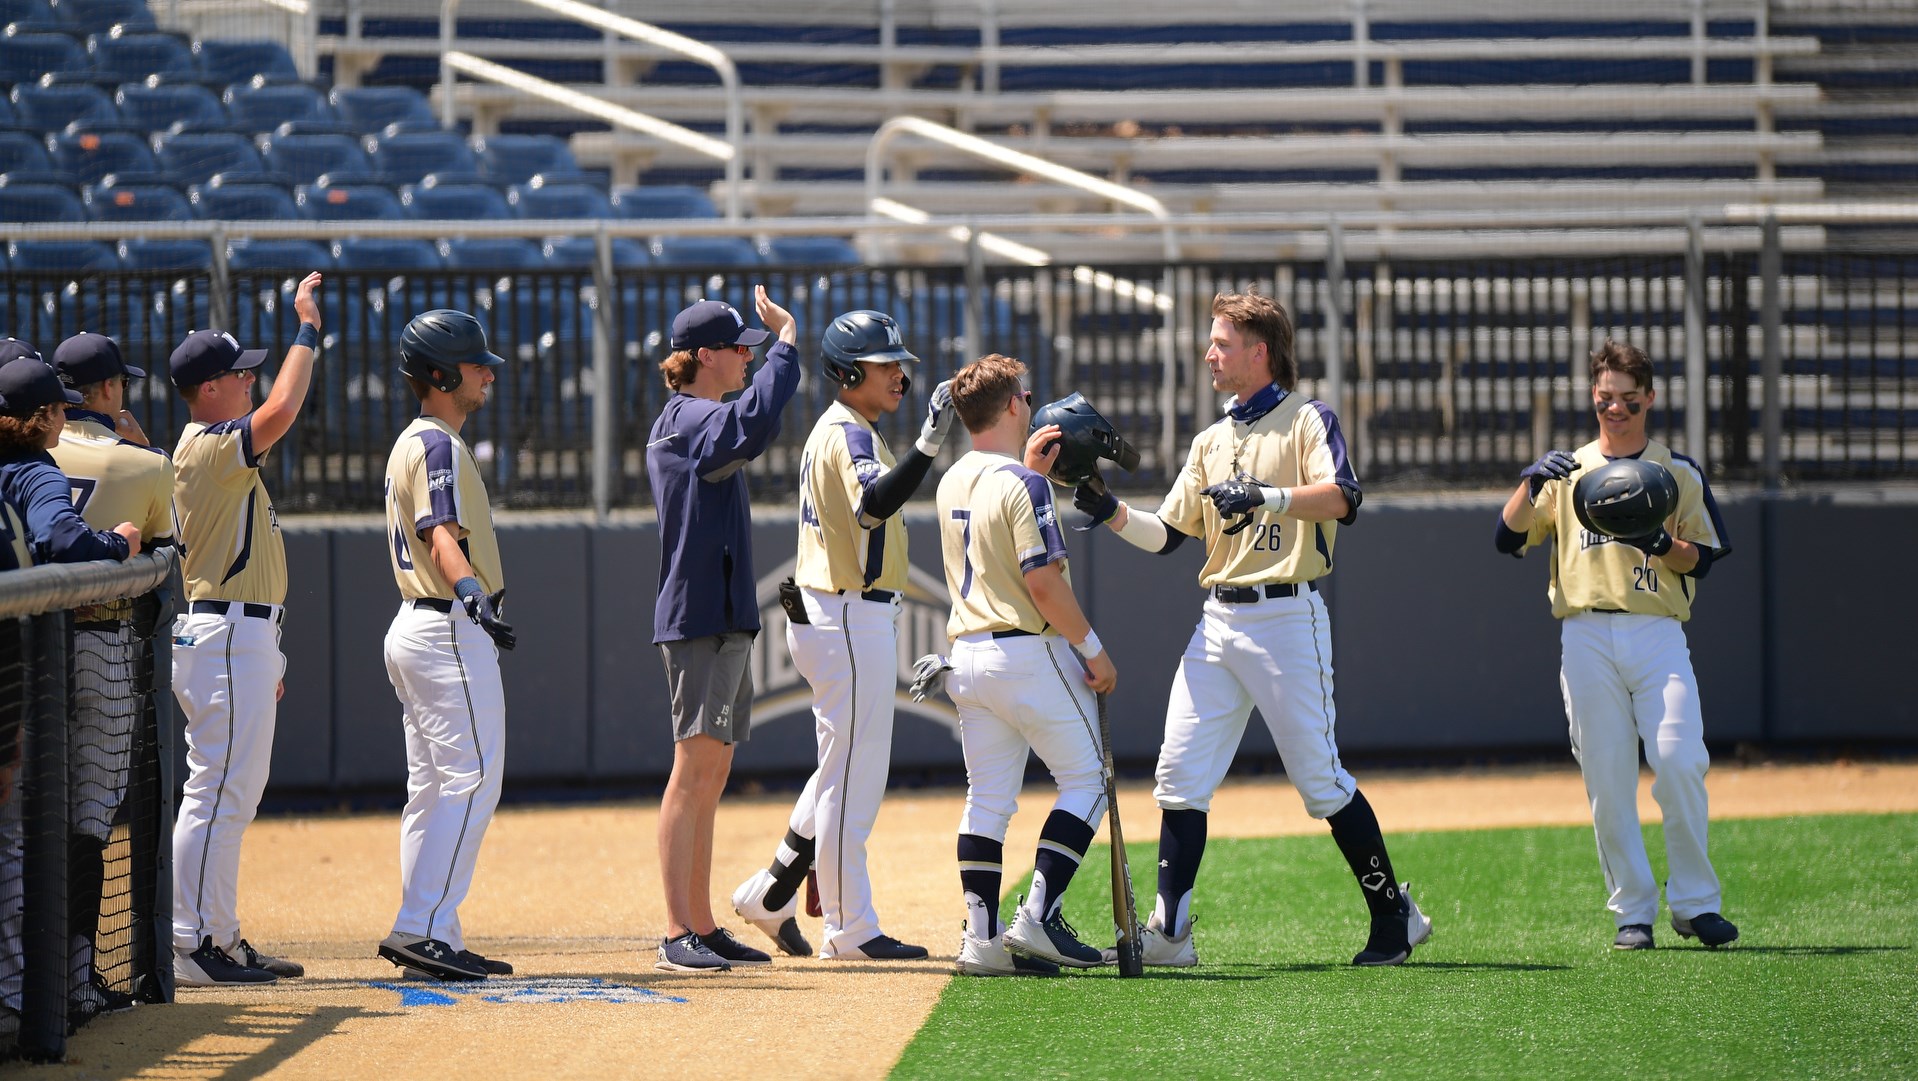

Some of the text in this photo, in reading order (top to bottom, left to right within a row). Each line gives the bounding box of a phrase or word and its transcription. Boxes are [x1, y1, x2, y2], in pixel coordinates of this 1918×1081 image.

[885, 325, 903, 345] M
[430, 475, 455, 489] NEC
[1253, 523, 1281, 551] 26
[951, 509, 973, 600] 7
[1633, 566, 1658, 592] 20
[721, 704, 730, 715] 19
